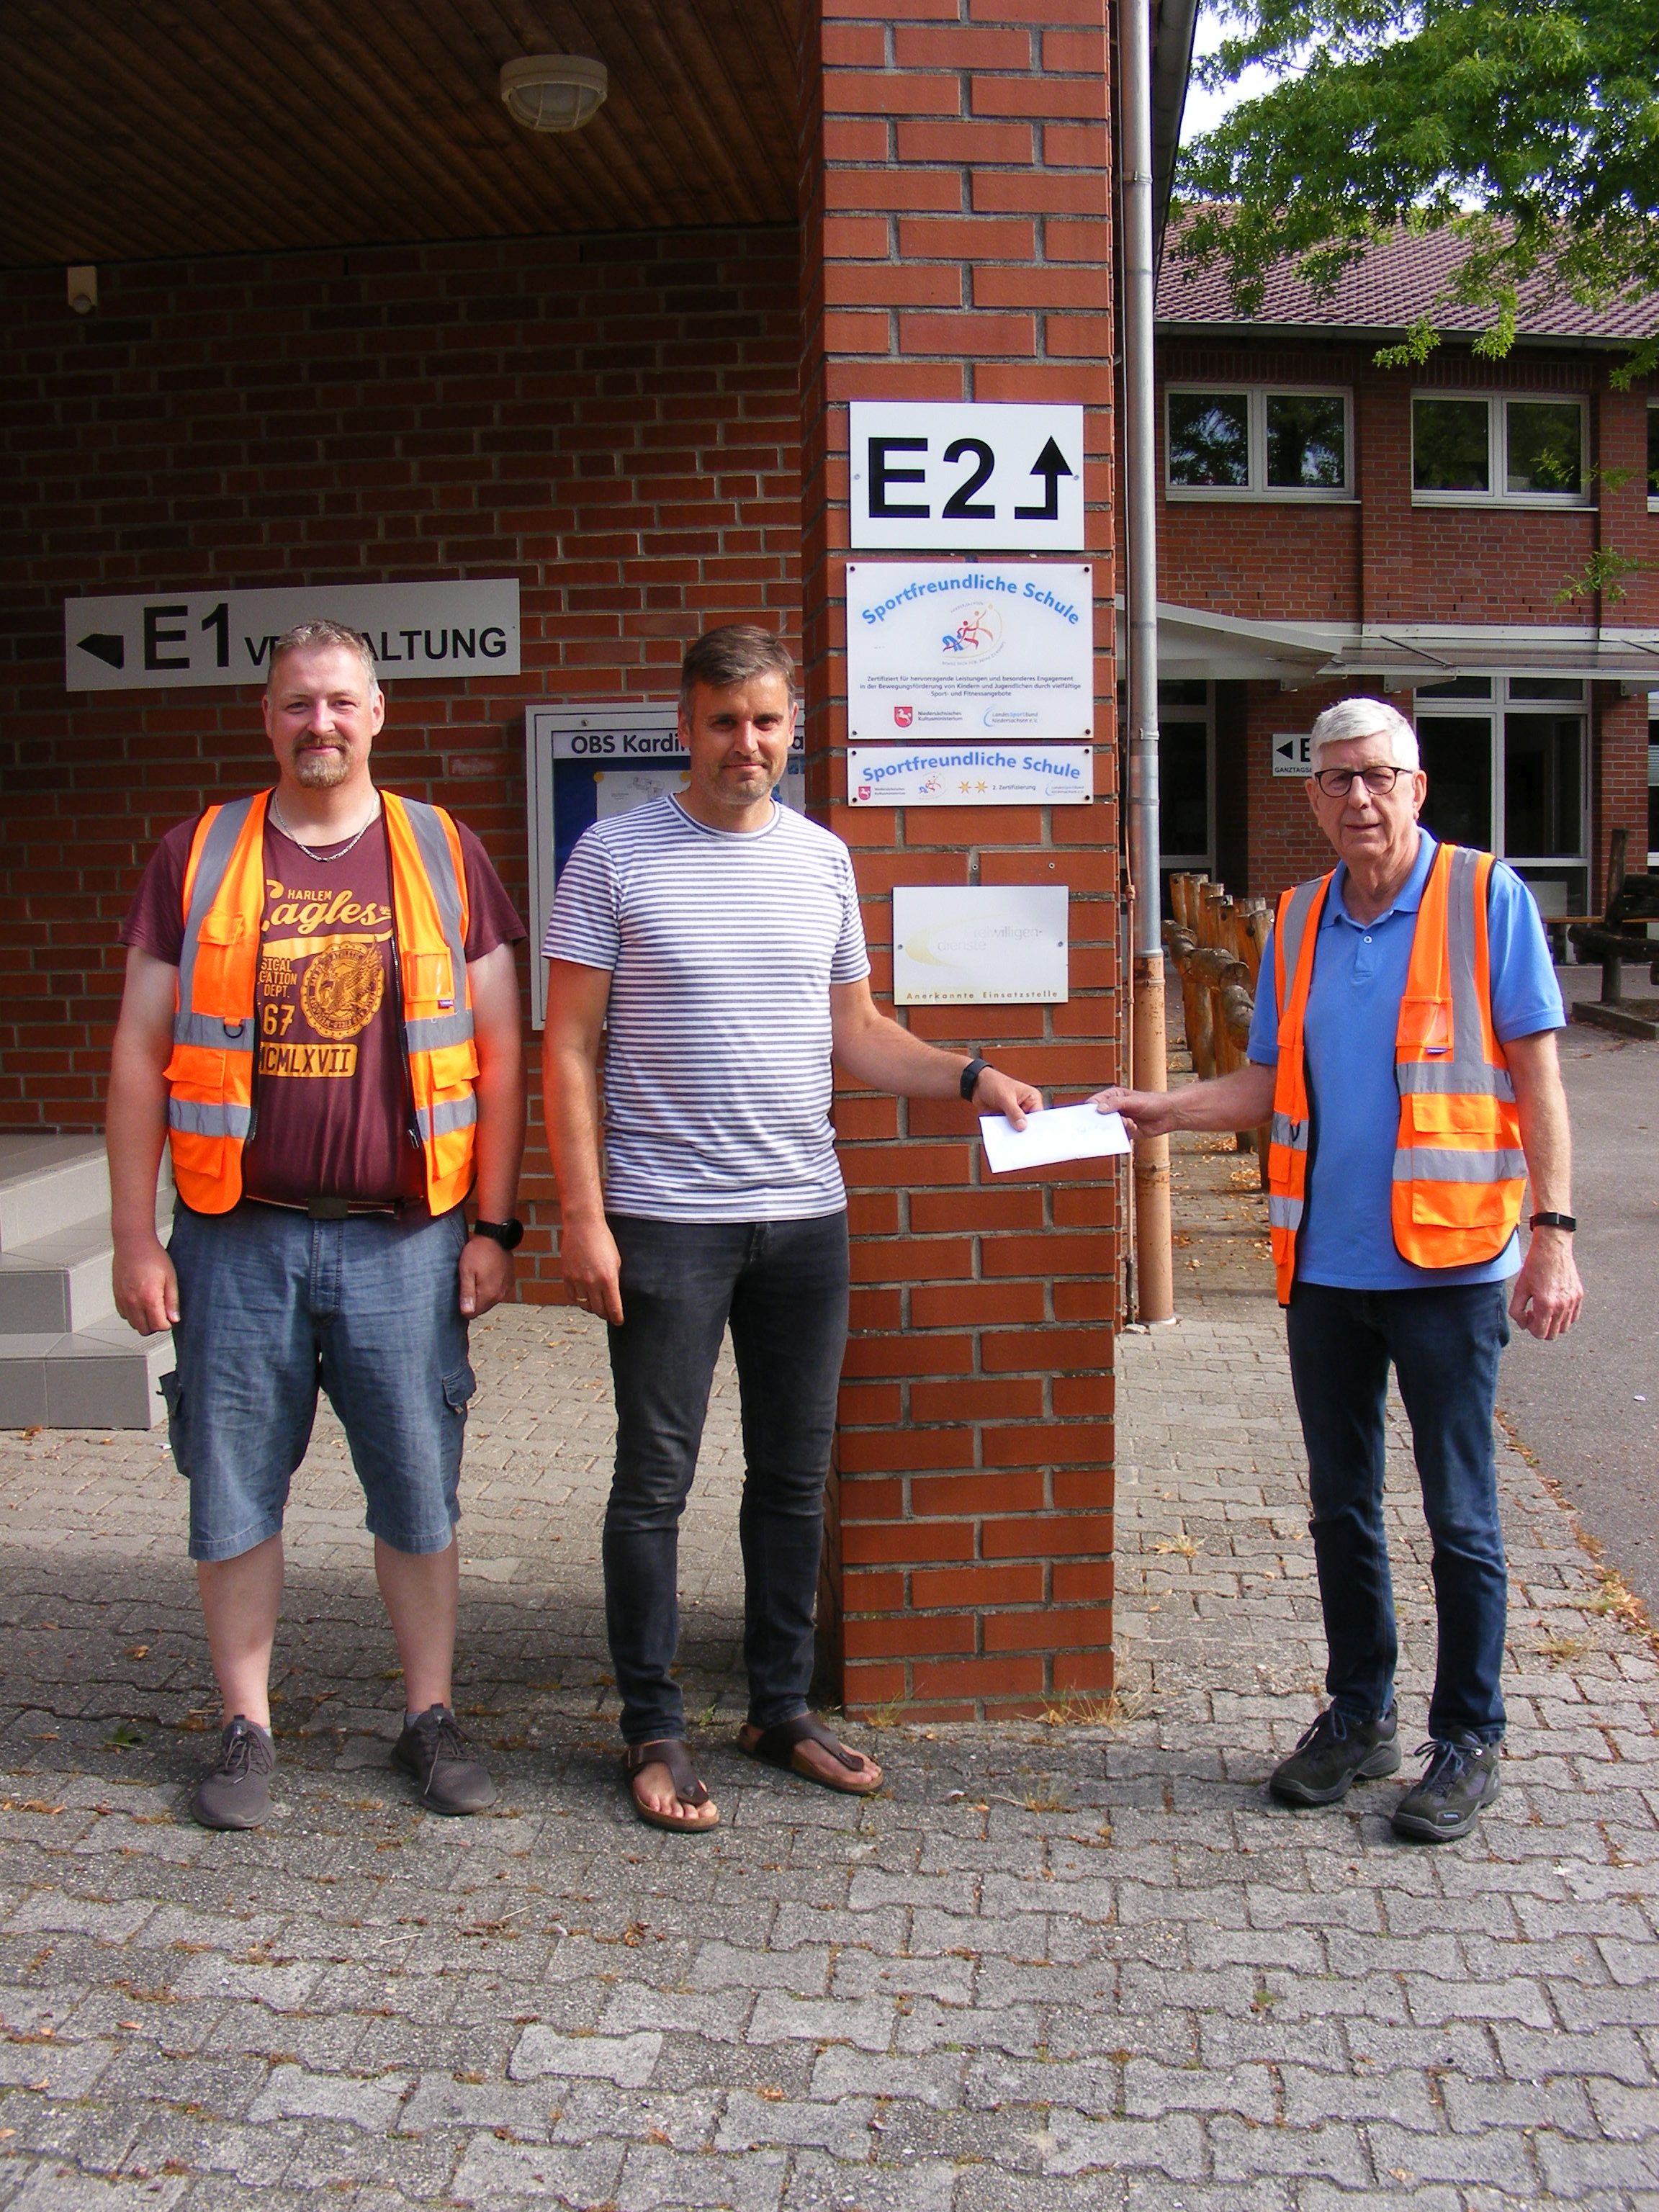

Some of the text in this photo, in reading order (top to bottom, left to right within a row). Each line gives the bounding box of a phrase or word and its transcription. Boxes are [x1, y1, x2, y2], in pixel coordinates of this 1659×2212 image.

[868, 436, 996, 519] E2
[862, 574, 1079, 625] Sportfreundliche Schule
[143, 603, 506, 670] E1 VLTUNG
[571, 734, 616, 754] OBS
[863, 752, 1081, 782] Sportfreundliche Schule
[288, 889, 333, 902] HARLEM
[966, 925, 1043, 940] reiwilligen-
[264, 984, 290, 999] DEPT.
[907, 990, 1058, 1000] Anerkannte Einsatzstelle
[262, 1003, 296, 1036] 67
